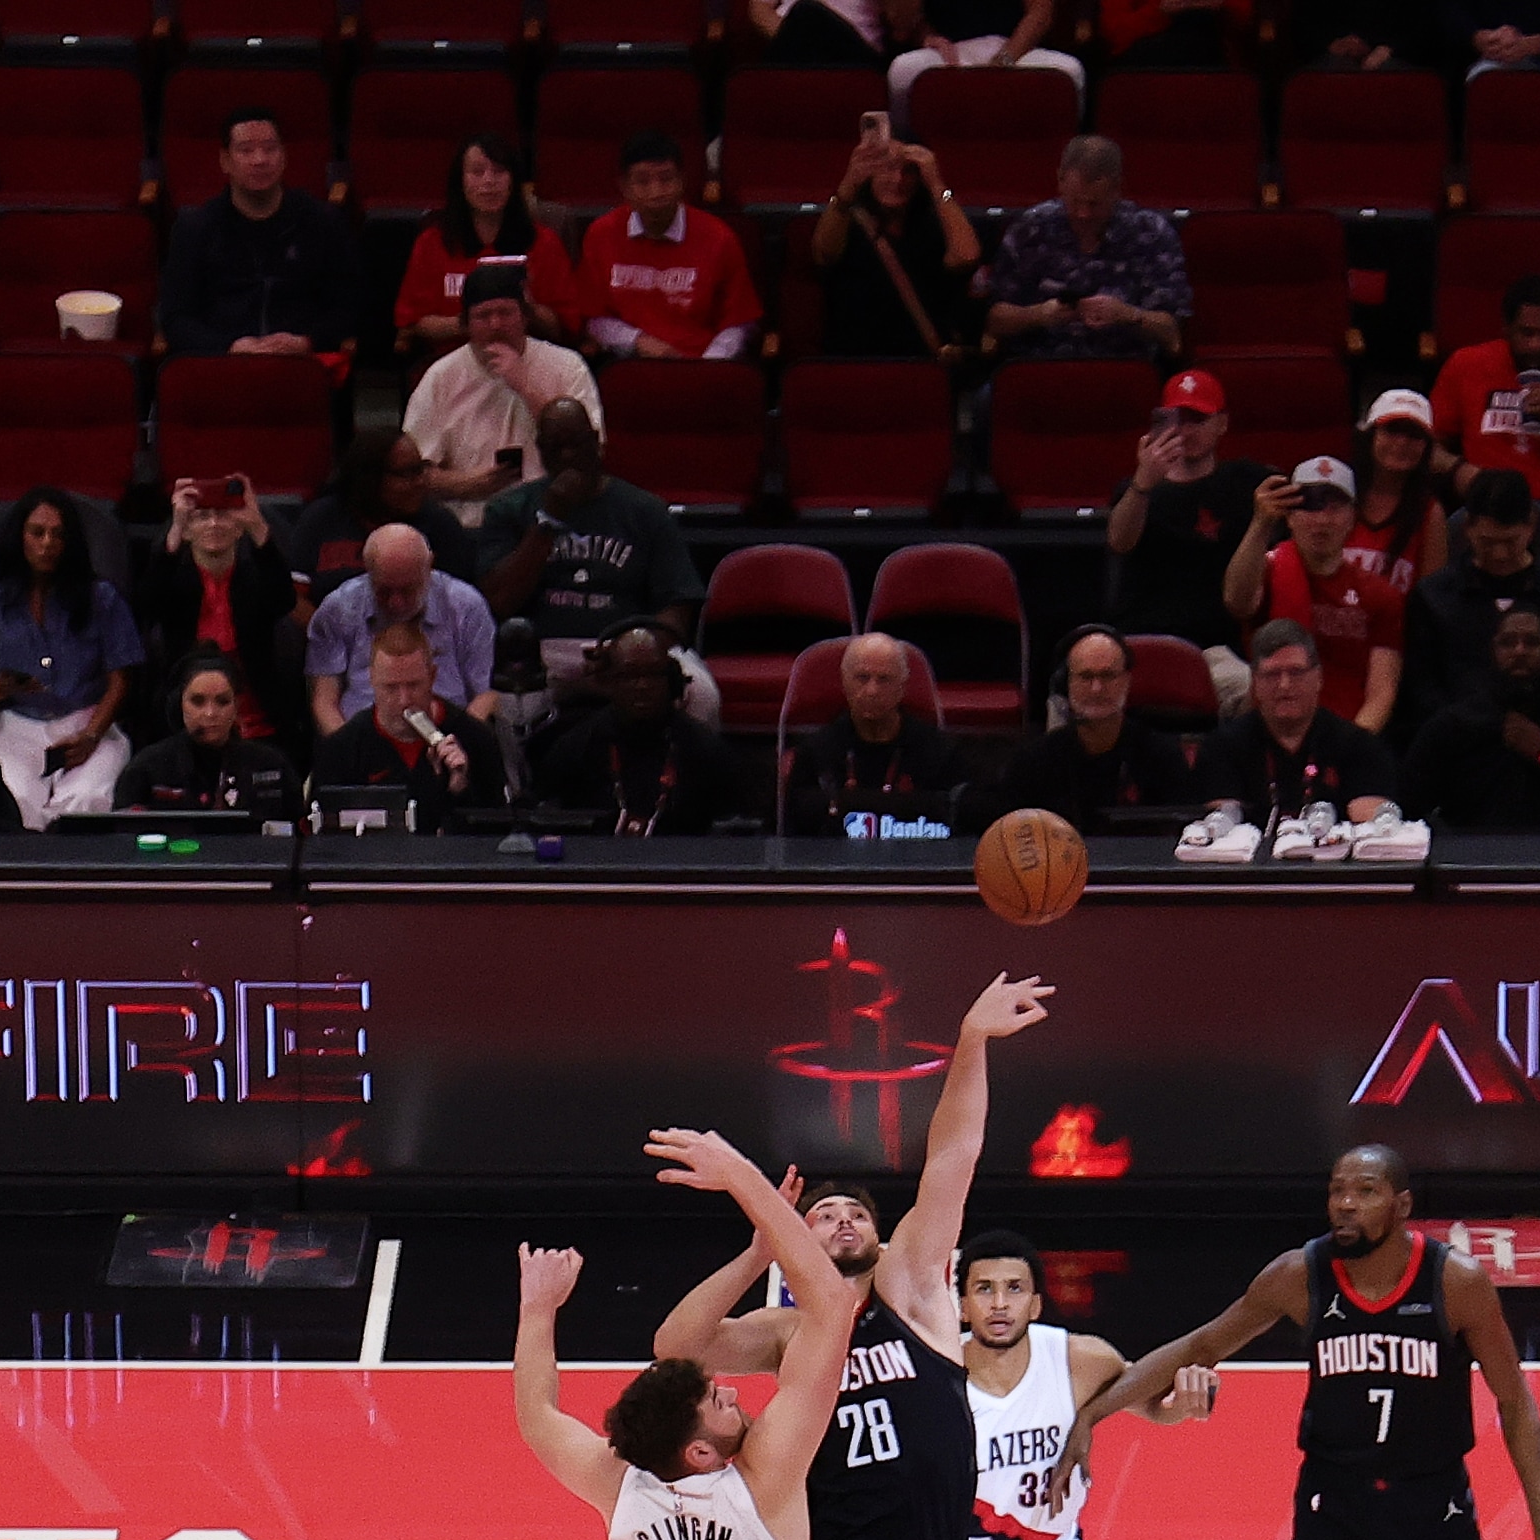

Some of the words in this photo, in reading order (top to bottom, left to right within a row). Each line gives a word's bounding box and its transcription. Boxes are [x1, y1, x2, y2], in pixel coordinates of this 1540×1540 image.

[1317, 1333, 1439, 1378] HOUSTON
[836, 1397, 901, 1468] 28
[1368, 1387, 1395, 1443] 7
